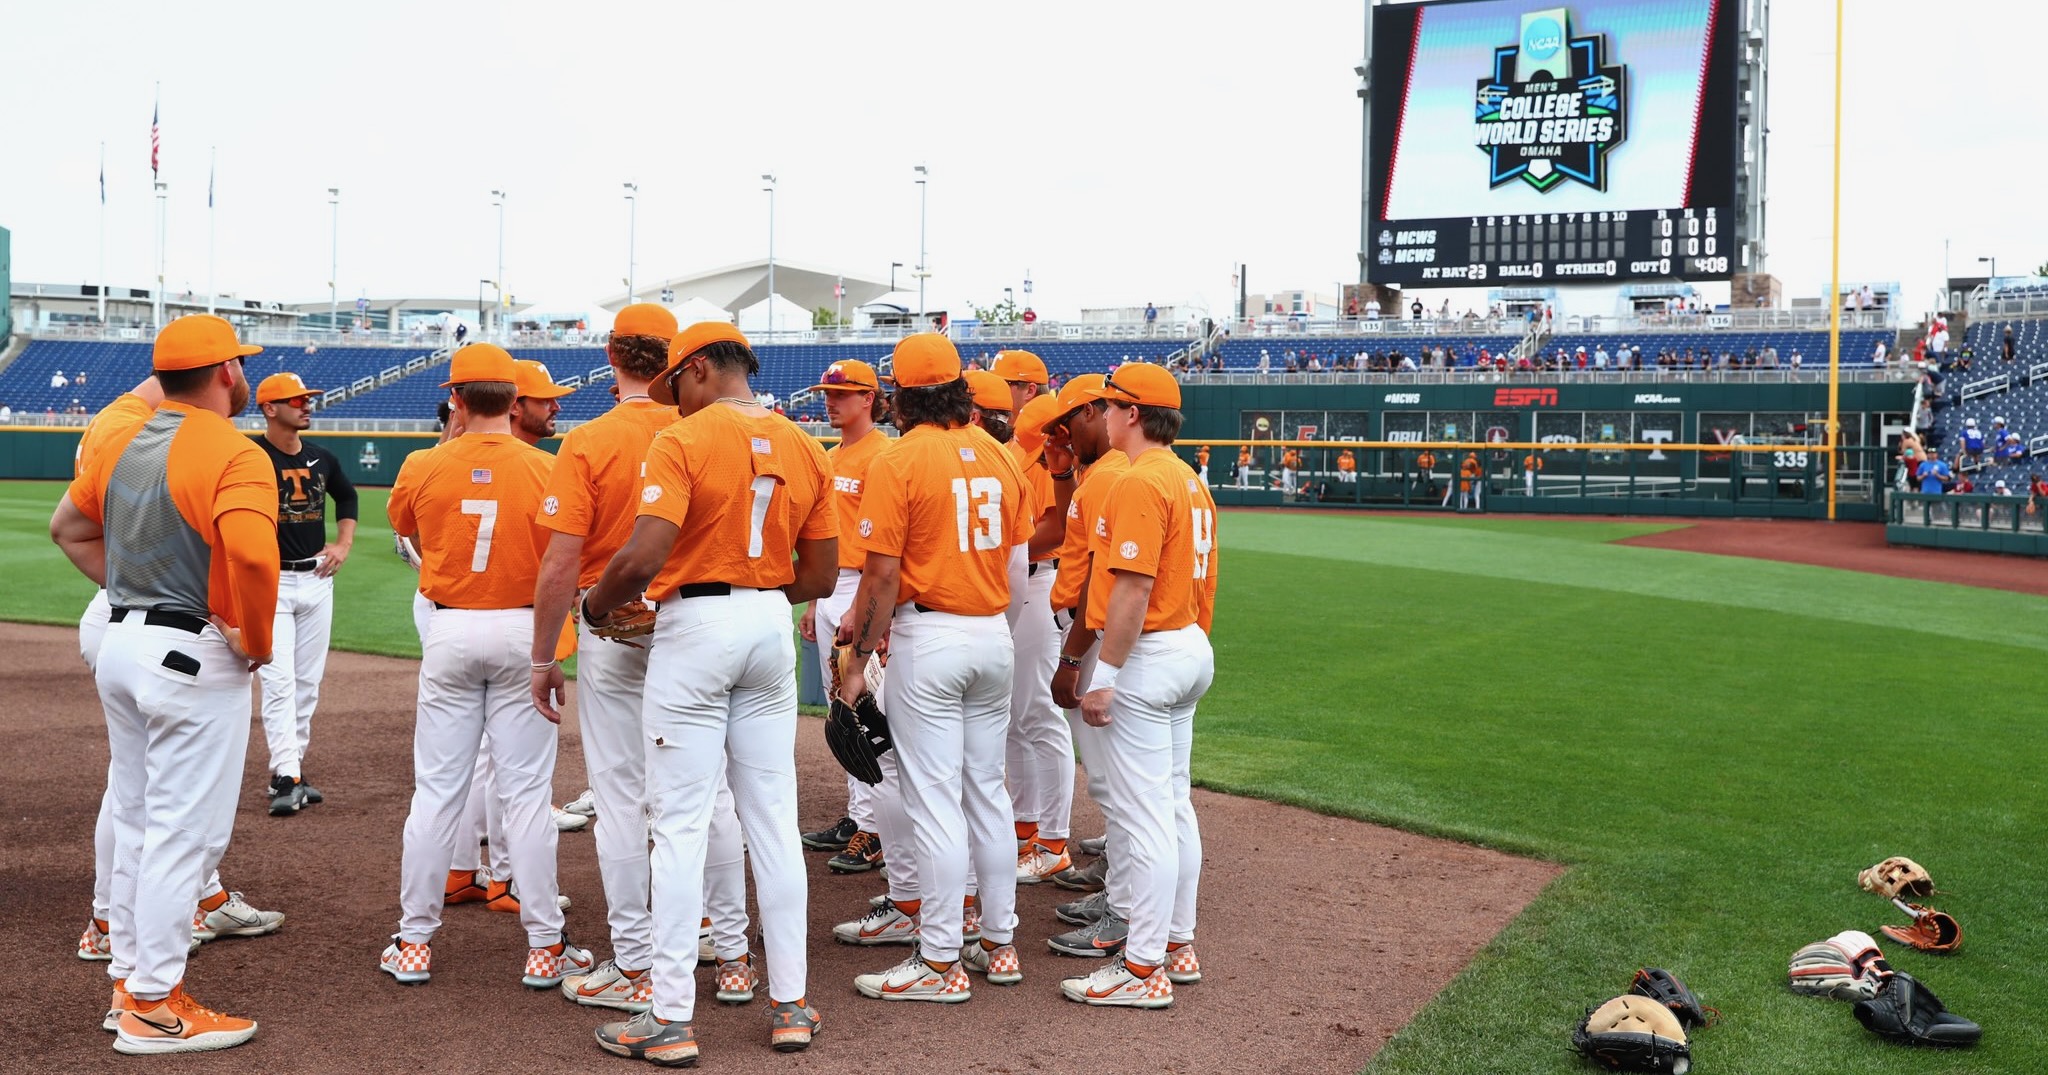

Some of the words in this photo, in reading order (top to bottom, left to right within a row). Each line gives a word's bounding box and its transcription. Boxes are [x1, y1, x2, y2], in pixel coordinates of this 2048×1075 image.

[1527, 36, 1561, 51] NCAA
[1524, 81, 1559, 94] MEN'S
[1499, 92, 1583, 121] COLLEGE
[1474, 120, 1538, 145] WORLD
[1539, 116, 1614, 144] SERIES
[1519, 145, 1562, 157] OMAHA
[1486, 216, 1495, 226] 2
[1502, 216, 1511, 226] 3
[1518, 215, 1527, 225] 4
[1534, 214, 1543, 224] 5
[1567, 213, 1575, 223] 7
[1583, 212, 1592, 223] 8
[1613, 211, 1628, 221] 10
[1395, 230, 1437, 246] MCWS
[1661, 219, 1672, 237] 0
[1688, 218, 1699, 236] 0
[1705, 217, 1716, 235] 0
[1394, 248, 1436, 264] MCWS
[1661, 238, 1672, 256] 0
[1688, 237, 1699, 256] 0
[1705, 236, 1716, 255] 0
[1422, 267, 1440, 279] AT
[1441, 266, 1468, 278] BAT
[1468, 264, 1487, 280] 23
[1498, 265, 1532, 277] BALL
[1555, 263, 1606, 275] STRIKE
[1630, 261, 1660, 273] OUT
[1384, 392, 1421, 404] #MCWS
[1493, 388, 1558, 406] ESPN
[1634, 393, 1681, 404] NCAA.com
[1773, 452, 1808, 468] 335
[748, 475, 777, 559] 1
[950, 476, 1004, 553] 13
[461, 499, 498, 572] 7
